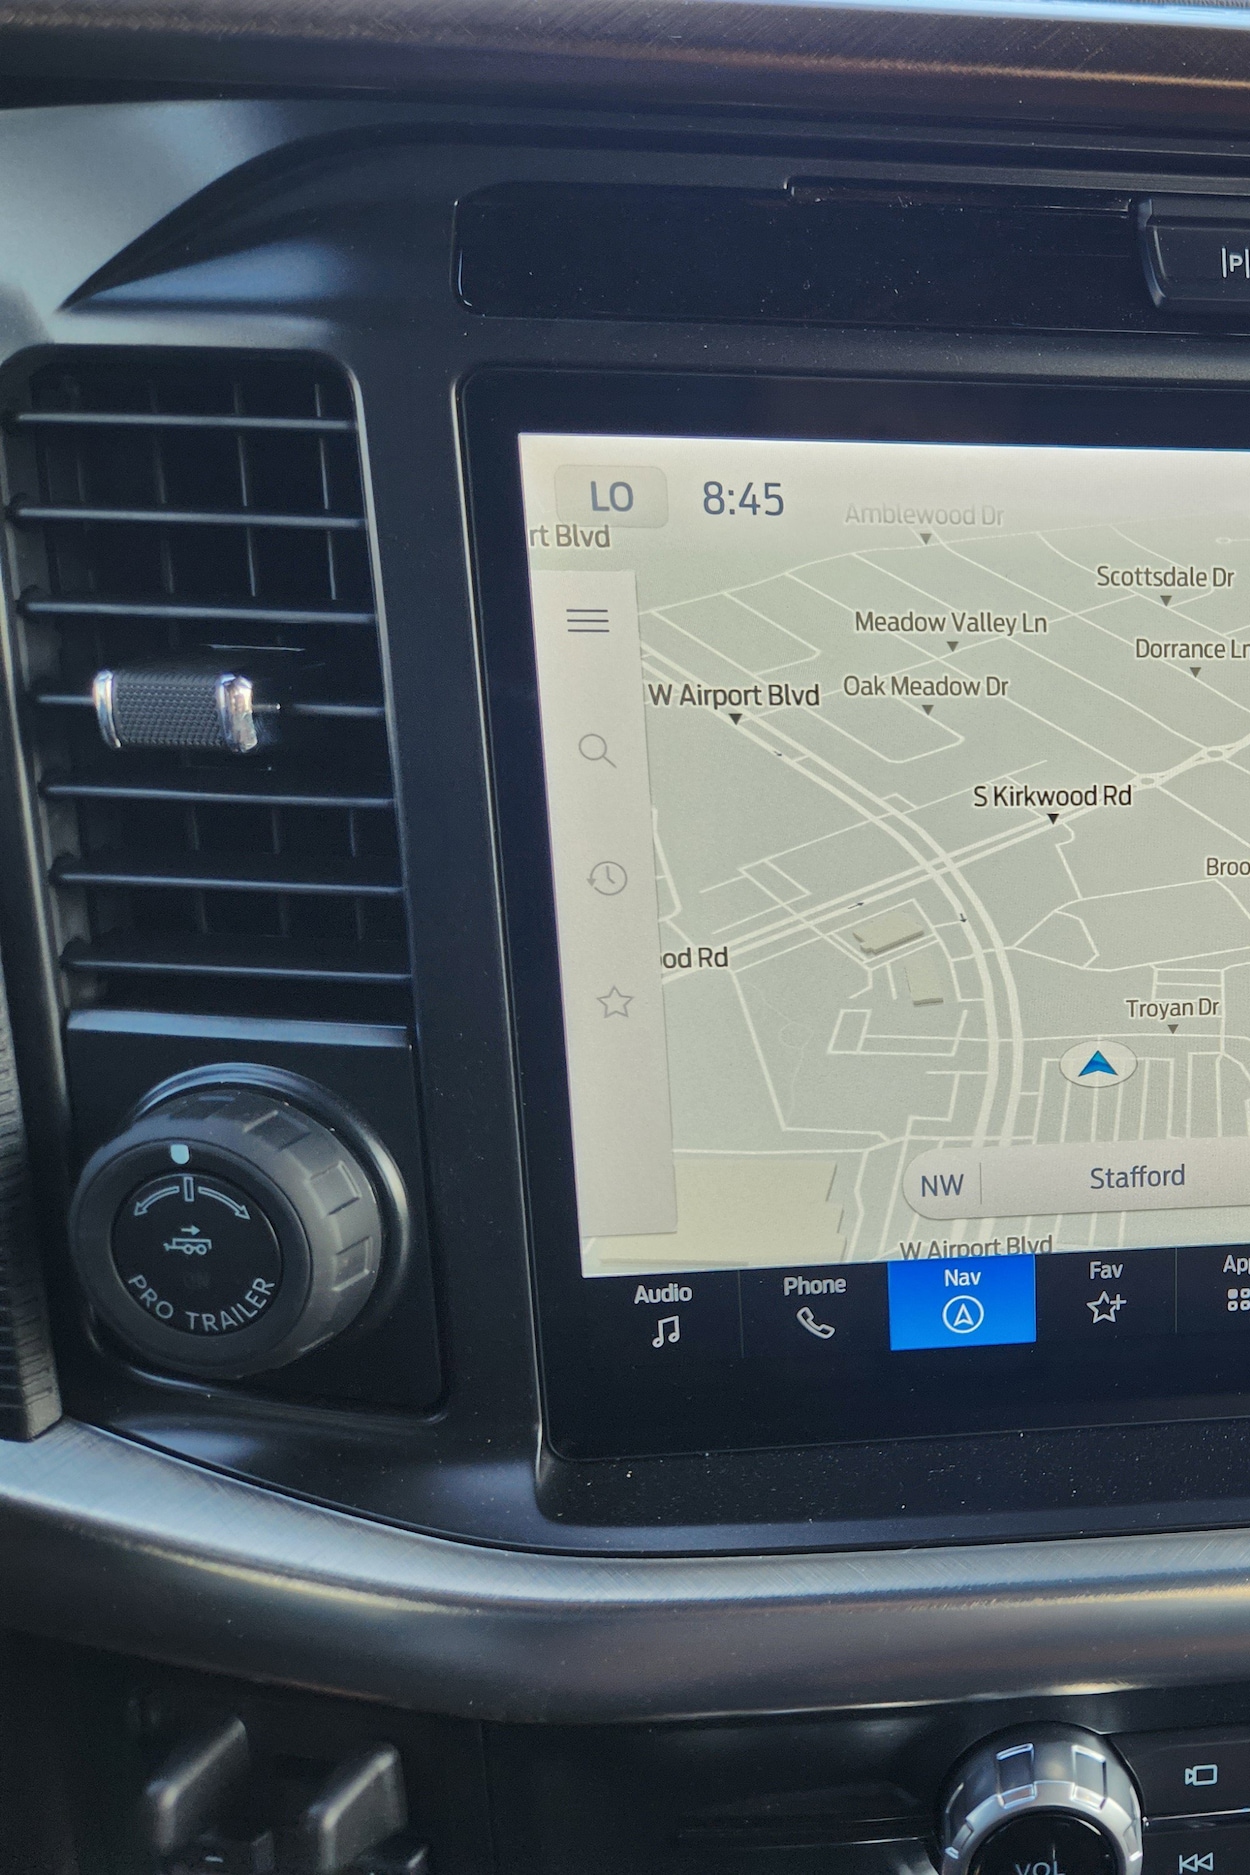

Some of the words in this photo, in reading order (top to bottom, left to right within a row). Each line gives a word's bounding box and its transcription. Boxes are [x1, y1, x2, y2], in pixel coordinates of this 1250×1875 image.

[590, 481, 634, 512] LO
[702, 482, 785, 516] 8:45
[845, 503, 976, 525] Amblewood
[981, 507, 1005, 525] Dr
[555, 524, 611, 548] Blvd
[1096, 566, 1208, 588] Scottsdale
[1212, 569, 1235, 588] Dr
[854, 611, 945, 633] Meadow
[950, 612, 1017, 637] Valley
[1022, 614, 1048, 633] Ln
[1135, 638, 1226, 660] Dorrance
[648, 684, 674, 706] W
[679, 684, 762, 711] Airport
[768, 683, 820, 707] Blvd
[843, 675, 887, 697] Oak
[890, 675, 980, 697] Meadow
[985, 677, 1009, 697] Dr
[973, 787, 989, 807] S
[993, 785, 1099, 807] Kirkwood
[1103, 785, 1133, 806] Rd
[660, 946, 692, 969] od
[698, 946, 728, 968] Rd
[1126, 999, 1194, 1023] Troyan
[1199, 998, 1220, 1016] Dr
[921, 1173, 965, 1197] NW
[1089, 1163, 1187, 1190] Stafford
[900, 1241, 922, 1260] W
[927, 1238, 1002, 1259] Airport
[1006, 1235, 1054, 1254] Blvd
[944, 1268, 982, 1287] Nav
[1089, 1260, 1124, 1280] Fav
[633, 1282, 693, 1305] Audio
[783, 1275, 847, 1296] Phone
[127, 1274, 175, 1320] PRO
[185, 1276, 276, 1333] TRAILER
